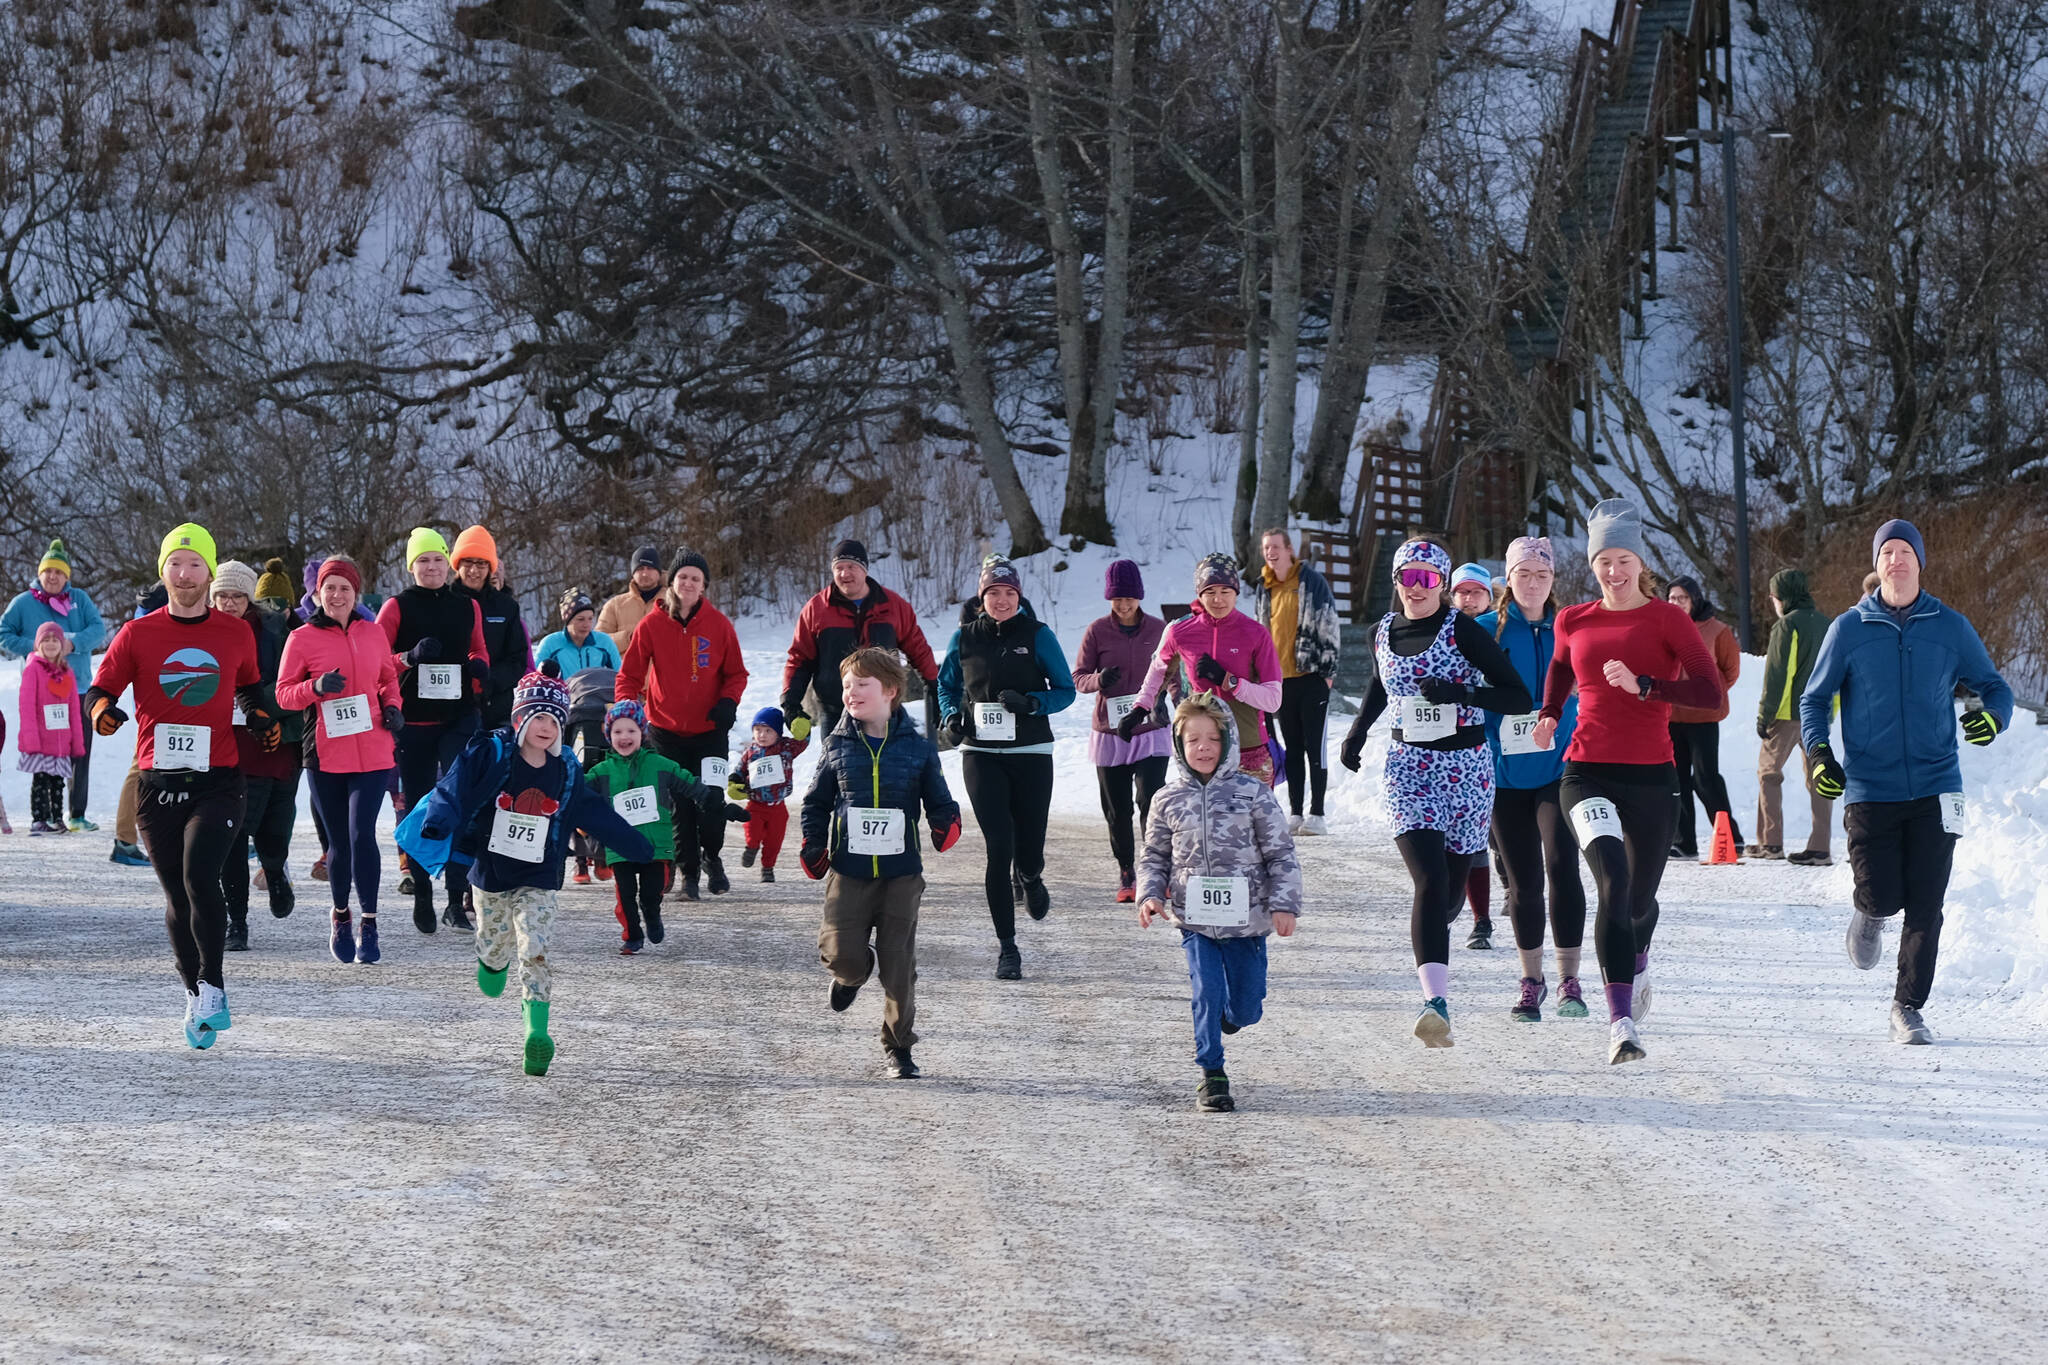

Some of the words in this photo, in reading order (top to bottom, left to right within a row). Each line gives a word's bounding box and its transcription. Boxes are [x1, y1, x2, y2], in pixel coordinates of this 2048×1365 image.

[430, 673, 450, 685] 960
[336, 706, 357, 721] 916
[983, 713, 1002, 725] 969
[1415, 708, 1441, 722] 956
[168, 737, 194, 752] 912
[625, 797, 646, 811] 902
[1583, 807, 1609, 823] 915
[508, 824, 535, 842] 975
[862, 821, 889, 836] 977
[1203, 890, 1232, 905] 903
